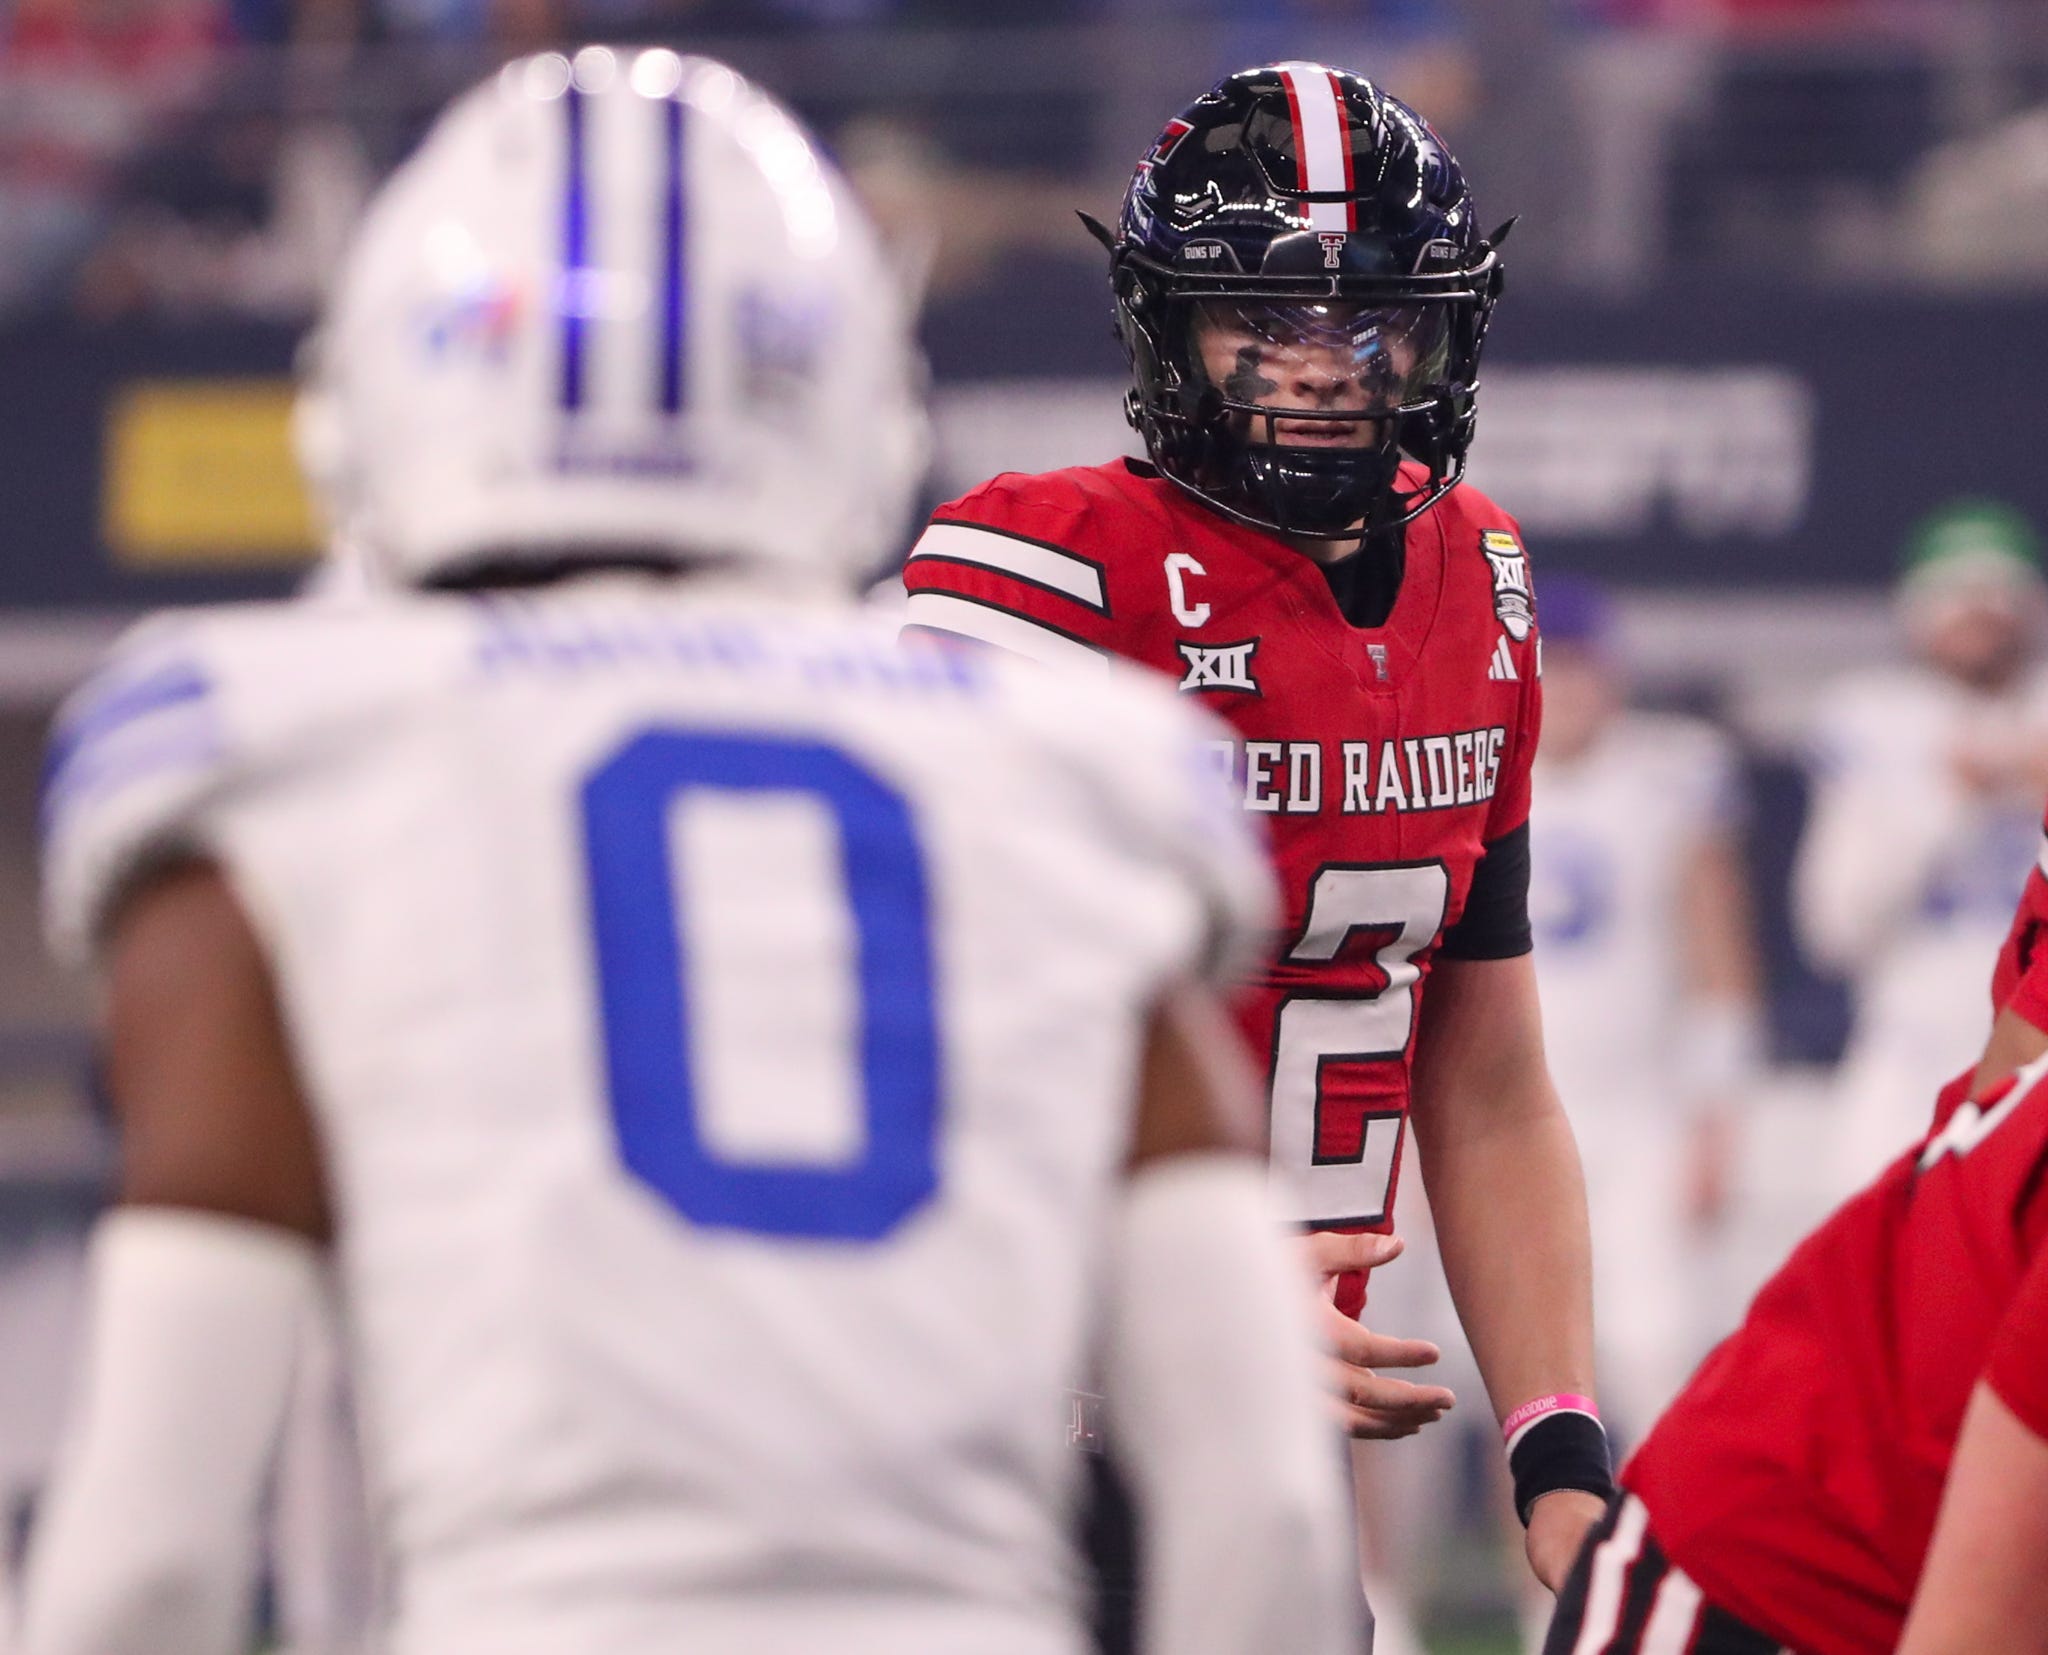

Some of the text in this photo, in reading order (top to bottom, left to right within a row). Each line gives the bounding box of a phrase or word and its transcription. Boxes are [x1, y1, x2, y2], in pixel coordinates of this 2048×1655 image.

[1184, 245, 1222, 259] GUNS UP
[1164, 553, 1210, 628] C
[1485, 551, 1528, 596] XII
[1178, 640, 1258, 693] XII
[1342, 727, 1505, 814] RAIDERS
[581, 726, 943, 1243] 0
[1267, 858, 1451, 1230] 2
